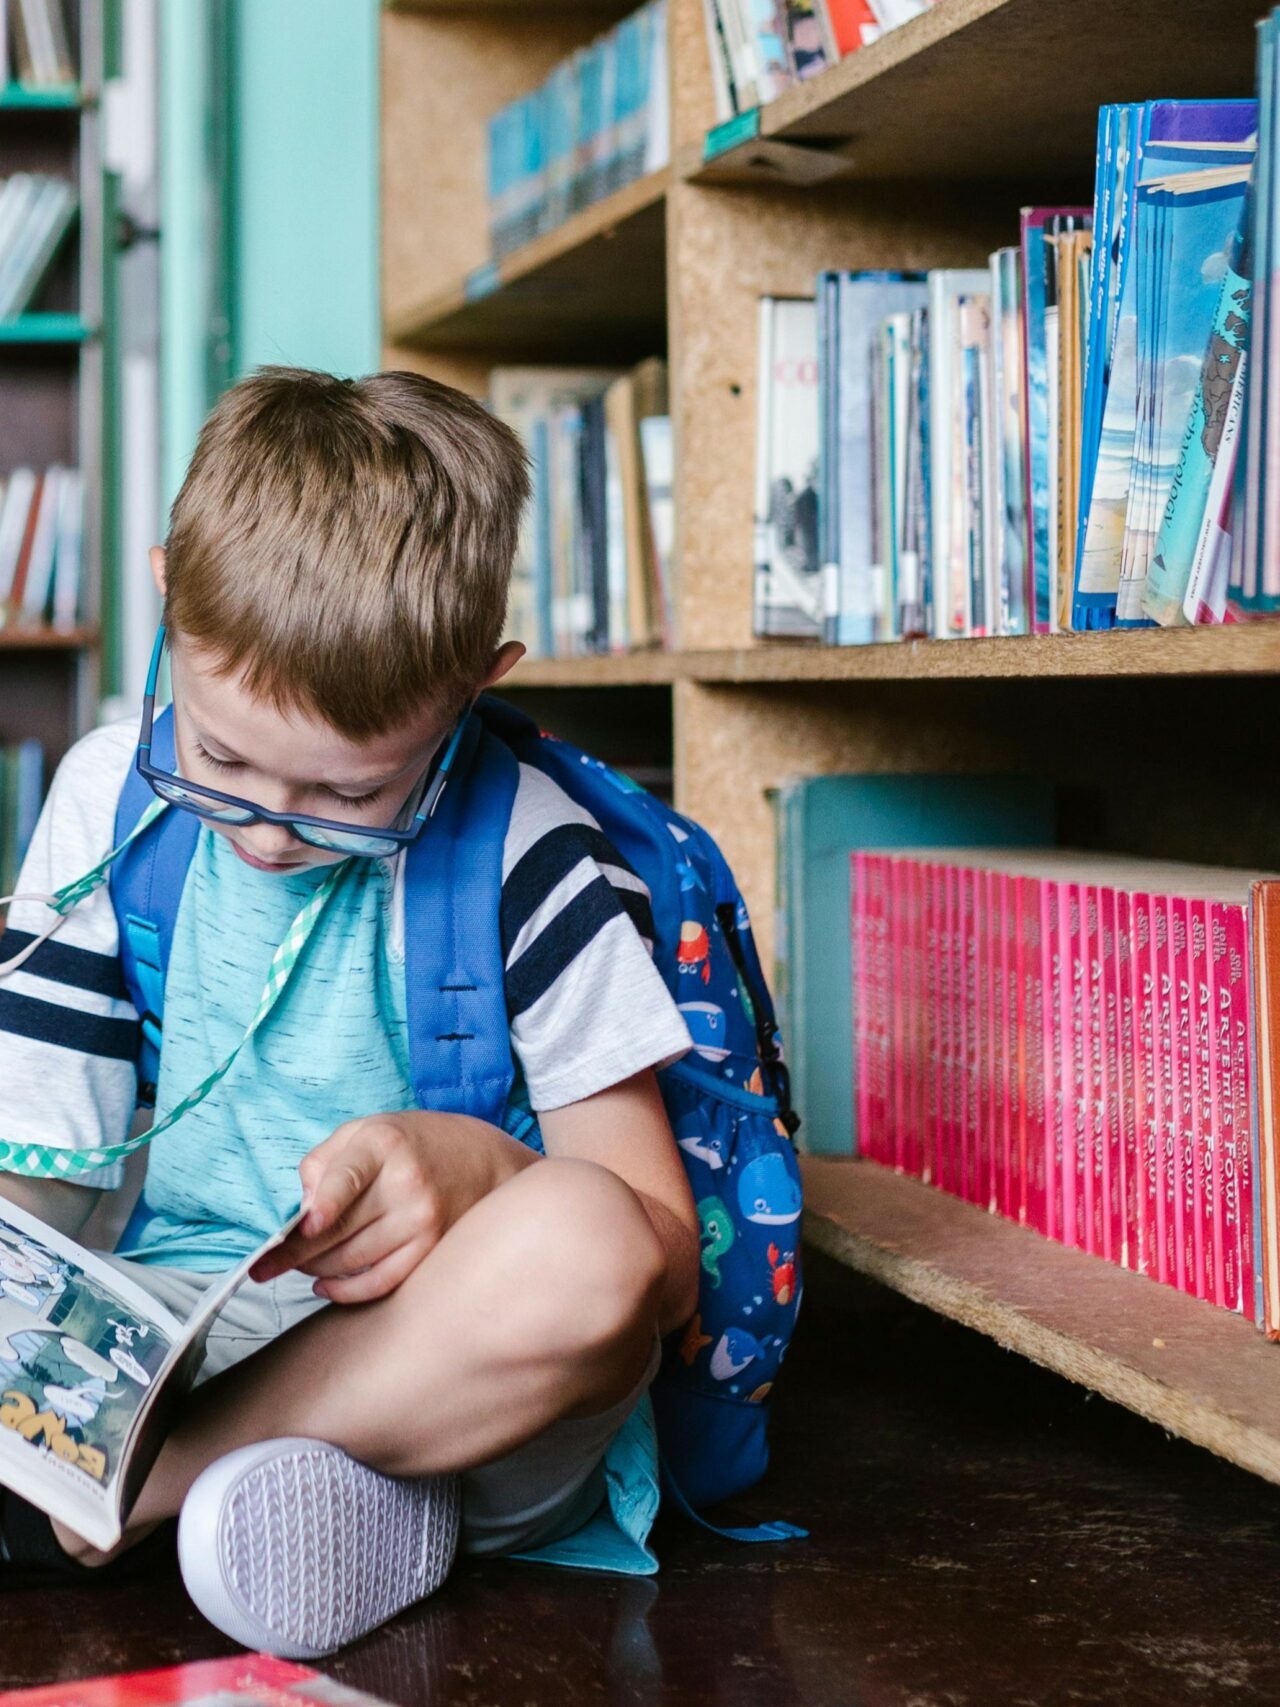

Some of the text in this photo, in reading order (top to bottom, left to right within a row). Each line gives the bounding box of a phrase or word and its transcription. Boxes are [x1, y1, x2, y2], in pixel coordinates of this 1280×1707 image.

[1212, 918, 1221, 962] COLFER
[1199, 983, 1215, 1219] ARTEMIS FOWL
[1220, 988, 1236, 1227] ARTEMIS FOWL
[1237, 1021, 1249, 1189] ARTEMIS FOWL
